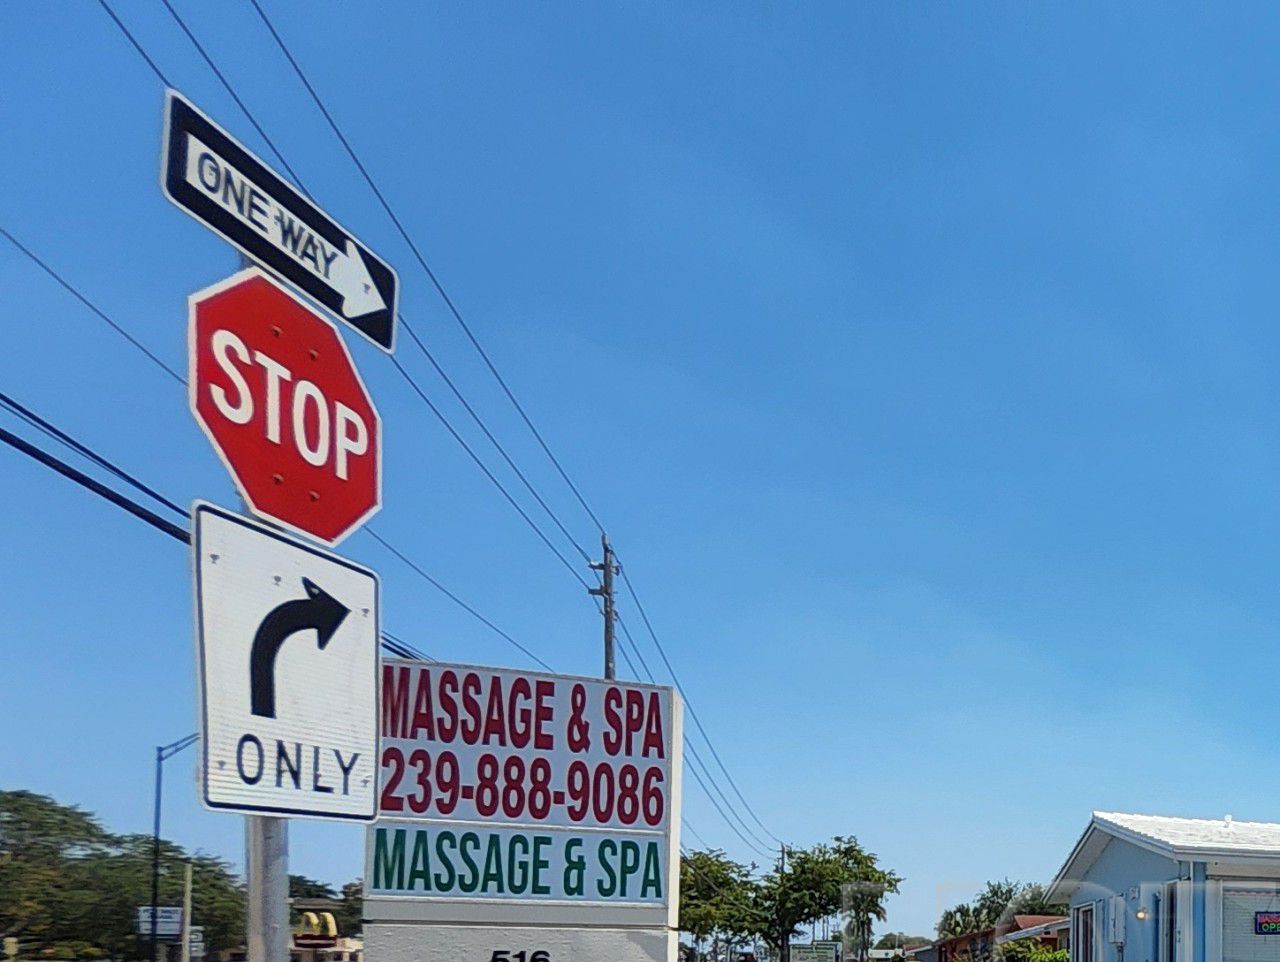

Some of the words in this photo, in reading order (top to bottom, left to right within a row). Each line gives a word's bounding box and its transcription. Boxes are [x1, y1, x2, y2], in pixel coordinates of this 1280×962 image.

[197, 151, 269, 234] ONE
[275, 211, 338, 281] WAY
[210, 329, 368, 481] STOP
[382, 664, 555, 751] MASSAGE
[567, 683, 591, 754] &
[602, 687, 665, 759] SPA
[236, 733, 360, 796] ONLY
[380, 747, 664, 826] 239-888-9086
[373, 828, 552, 895] MASSAGE
[563, 837, 586, 896] &
[597, 838, 662, 898] SPA
